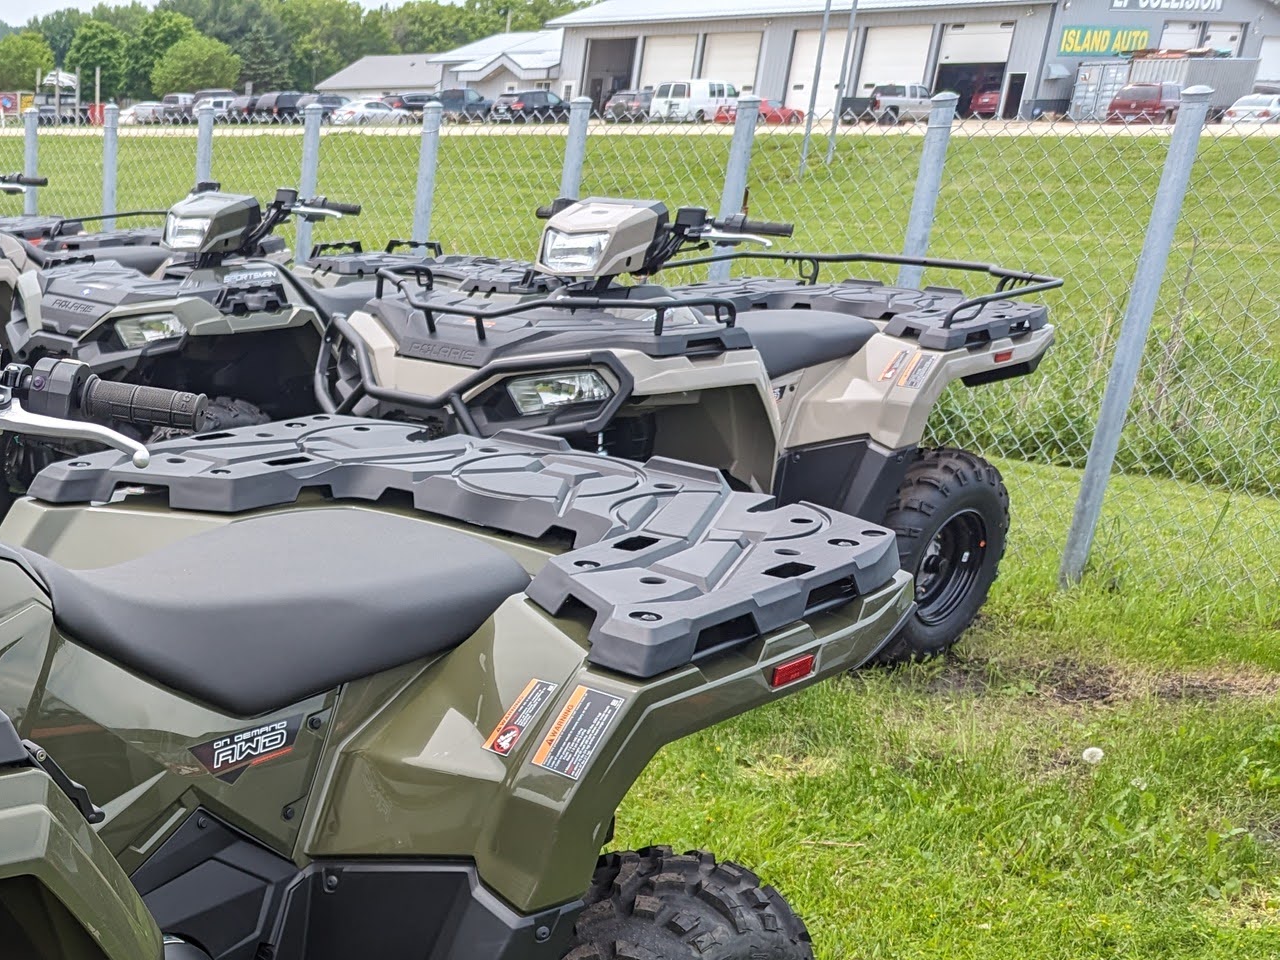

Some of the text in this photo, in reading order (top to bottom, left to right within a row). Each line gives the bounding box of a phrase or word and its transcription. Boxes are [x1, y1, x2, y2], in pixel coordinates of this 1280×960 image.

[1060, 29, 1150, 53] ISLAND AUTO
[223, 271, 277, 284] SPORTSMAN
[51, 299, 96, 314] POLARIS
[409, 342, 477, 361] POLARIS
[500, 695, 524, 728] WARNING
[549, 703, 575, 738] WARNING
[213, 721, 288, 749] ON DEMAND
[213, 729, 288, 769] AWD
